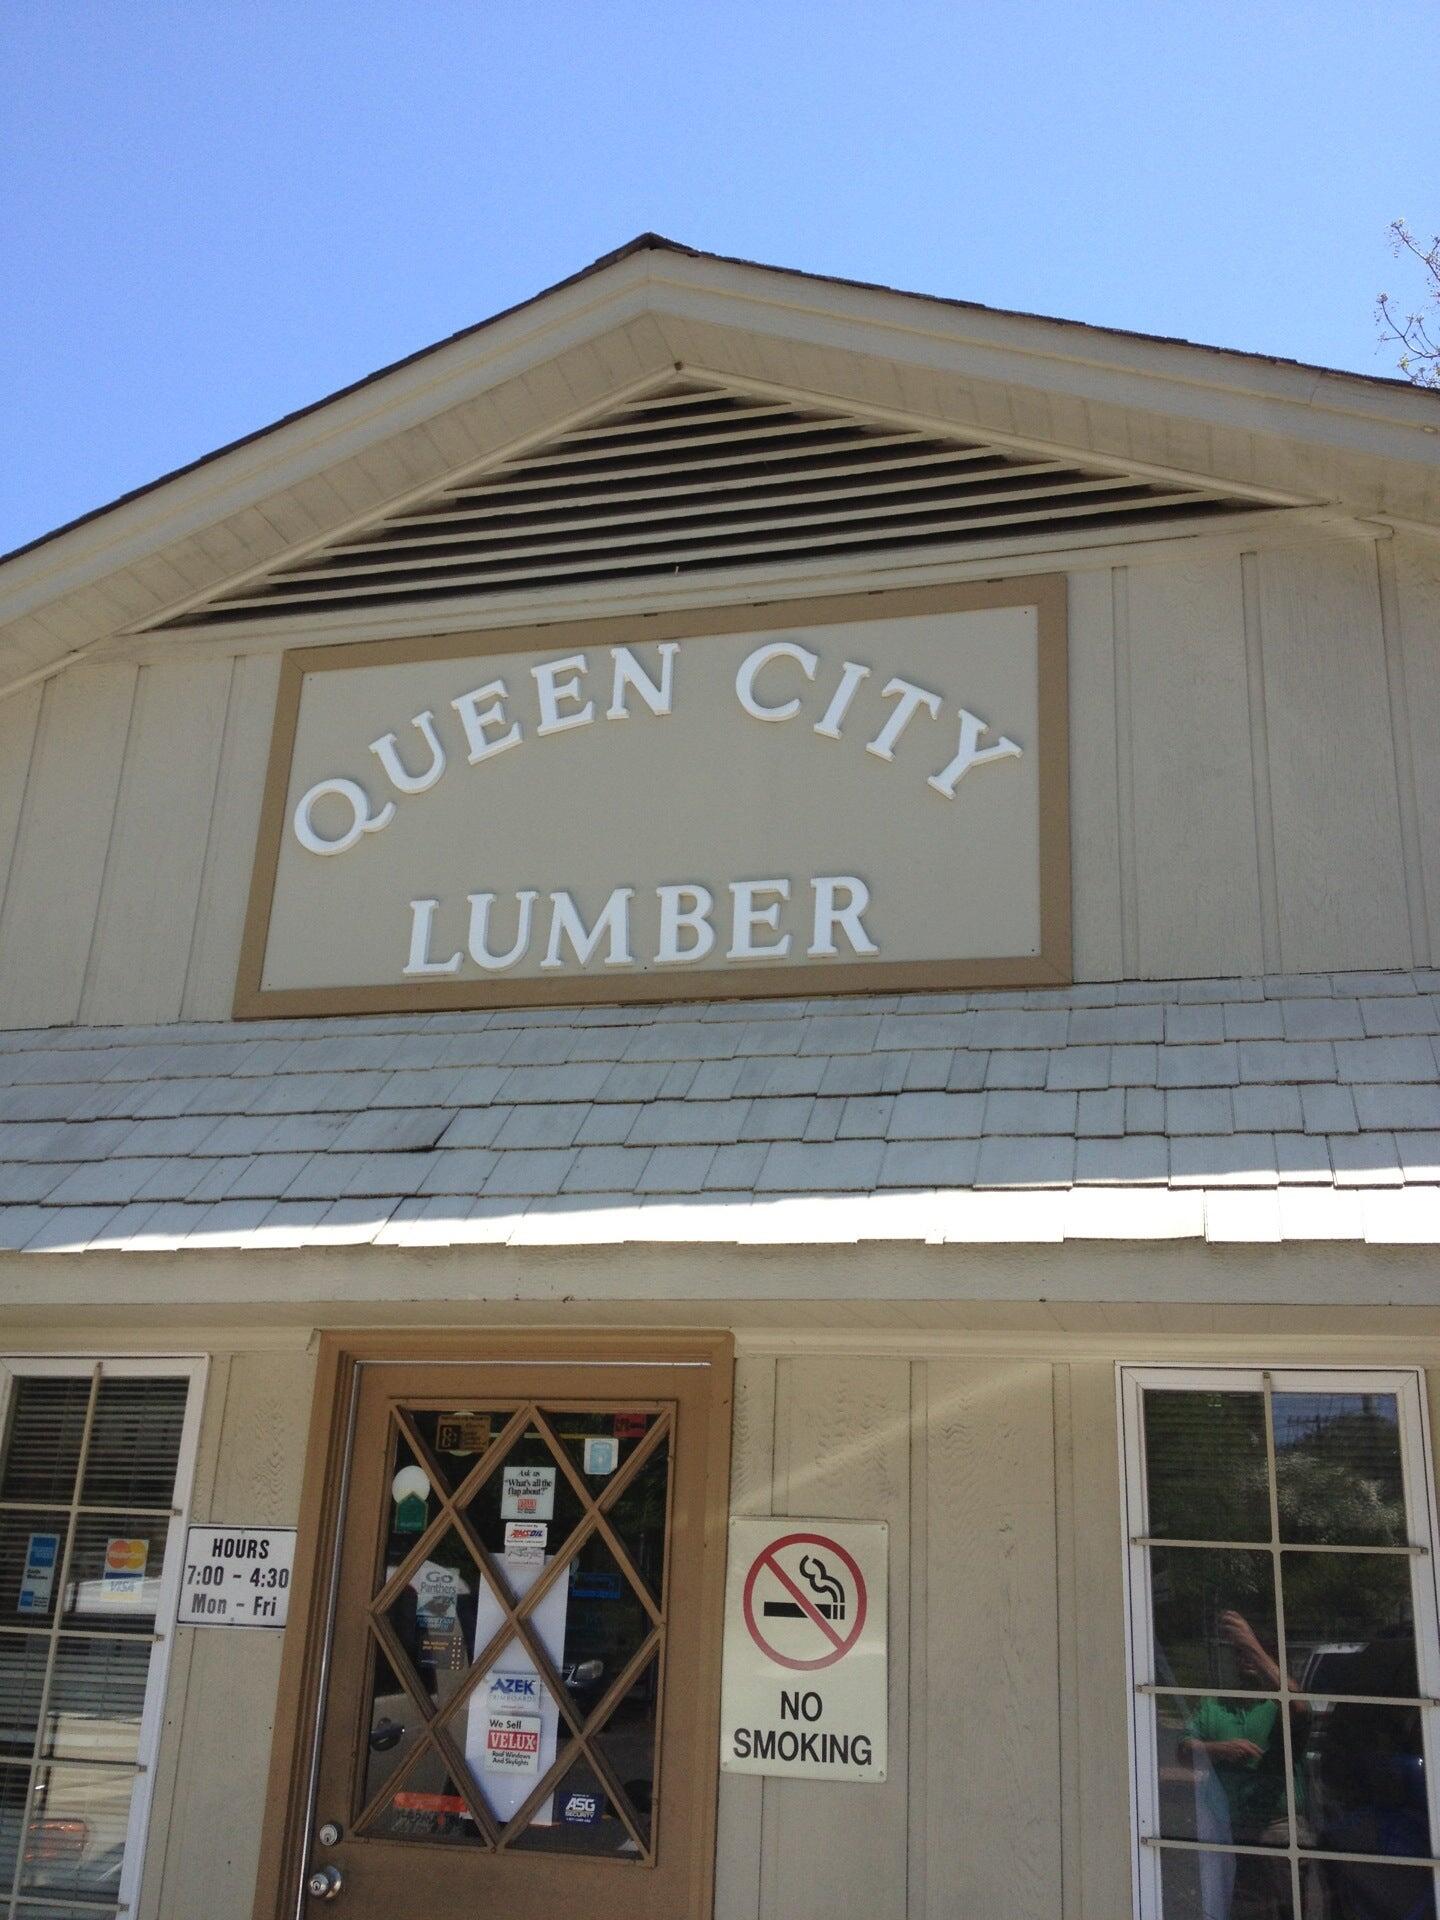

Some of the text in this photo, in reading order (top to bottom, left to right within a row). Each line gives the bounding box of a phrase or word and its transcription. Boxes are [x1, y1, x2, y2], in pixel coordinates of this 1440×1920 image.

[294, 643, 1022, 856] QUEEN CITY
[403, 876, 880, 976] LUMBER
[511, 1529, 543, 1538] AMSOIL
[212, 1538, 270, 1559] HOURS
[187, 1565, 224, 1586] 7:00
[250, 1567, 289, 1588] 4:30
[426, 1571, 453, 1583] Go
[110, 1581, 135, 1592] VISA
[421, 1581, 457, 1594] Panthers
[191, 1593, 227, 1614] Mon
[253, 1596, 277, 1616] Fri
[490, 1678, 536, 1695] AZEK
[780, 1691, 823, 1722] NO
[489, 1719, 522, 1729] We Sell
[490, 1732, 536, 1750] VELUX
[733, 1727, 872, 1766] SMOKING
[505, 1751, 531, 1759] Windows
[565, 1797, 596, 1811] ASG
